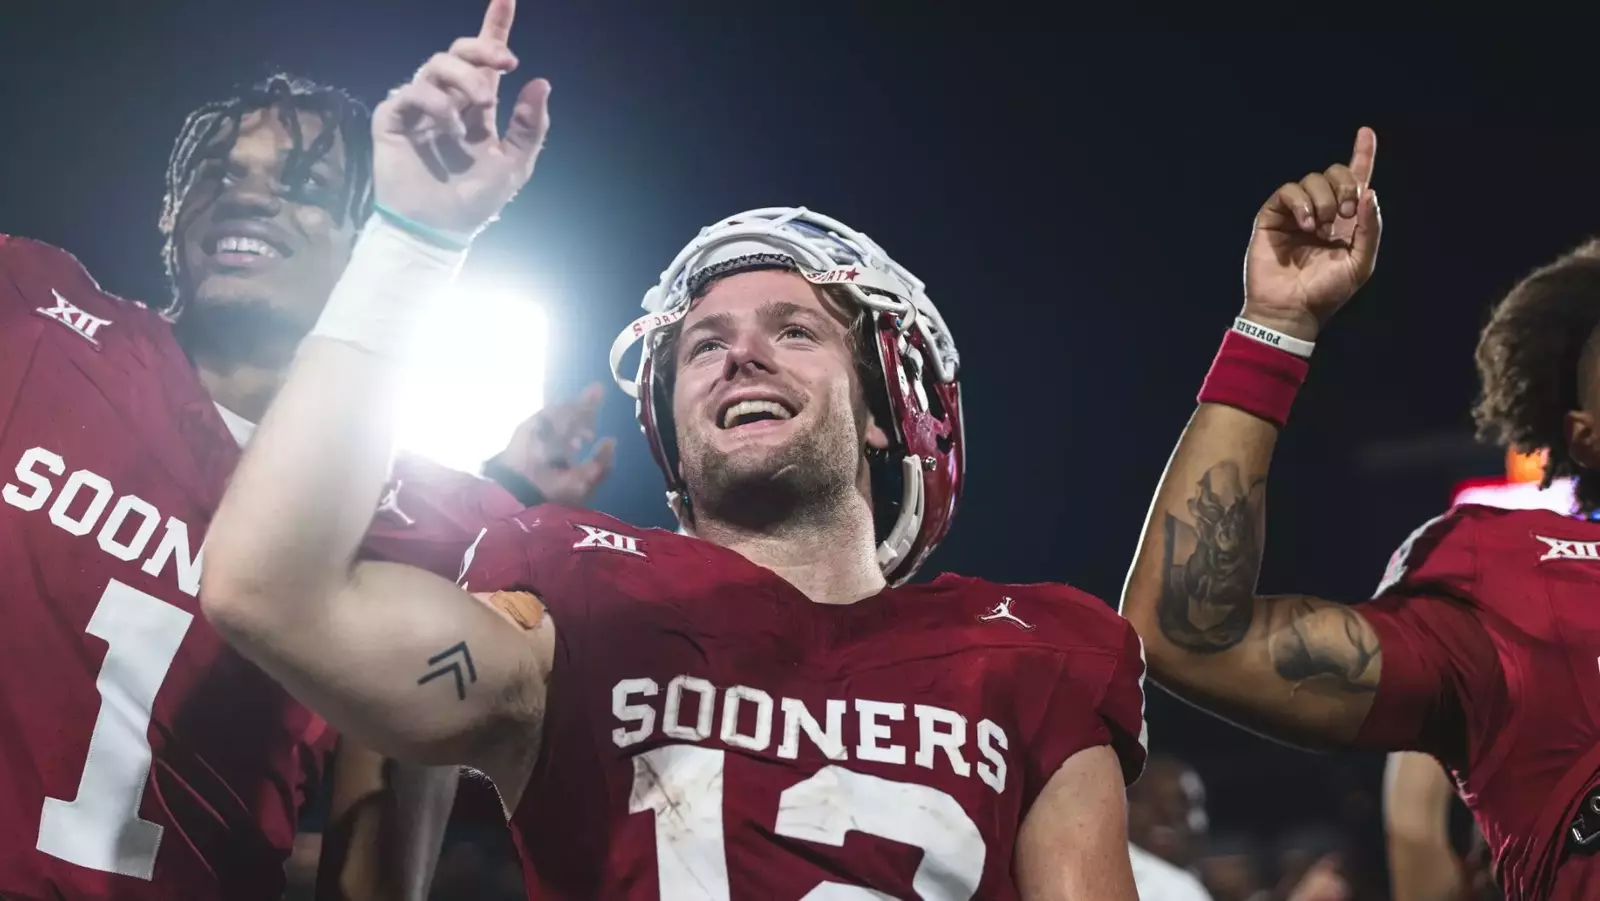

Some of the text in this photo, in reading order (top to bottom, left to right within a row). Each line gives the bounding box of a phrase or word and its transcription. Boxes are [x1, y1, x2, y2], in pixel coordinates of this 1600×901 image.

[632, 312, 678, 337] SORT
[36, 577, 195, 881] 1
[612, 675, 1009, 794] SOONERS
